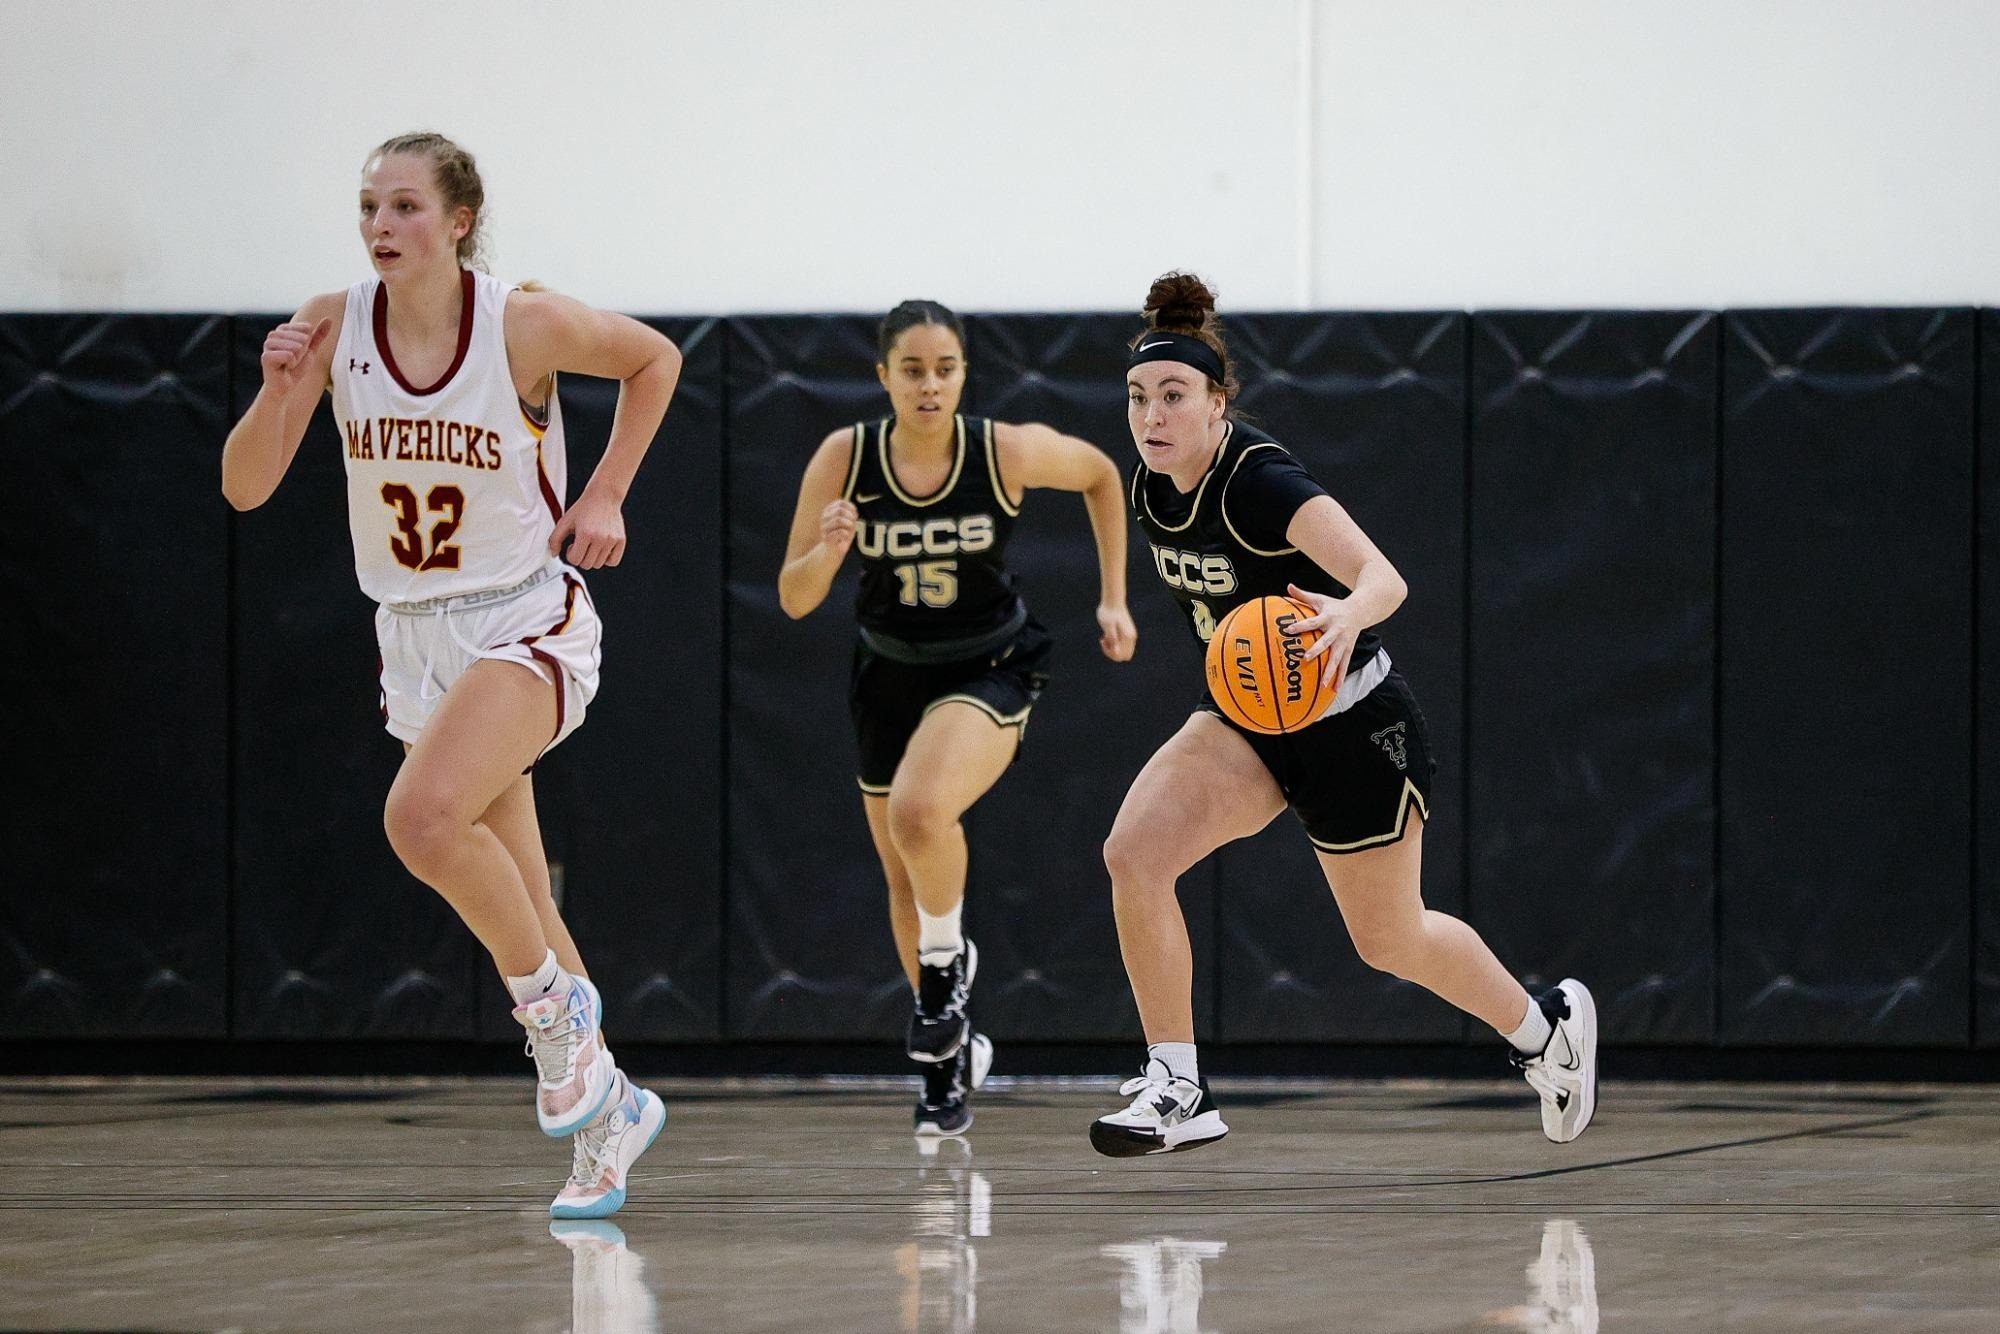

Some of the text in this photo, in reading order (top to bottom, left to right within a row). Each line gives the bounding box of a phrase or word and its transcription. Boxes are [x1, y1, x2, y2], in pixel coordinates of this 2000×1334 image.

[346, 417, 502, 471] MAVERICKS
[380, 481, 465, 572] 32
[854, 514, 994, 559] UCCS
[894, 560, 959, 609] 15
[1235, 638, 1258, 692] EVO
